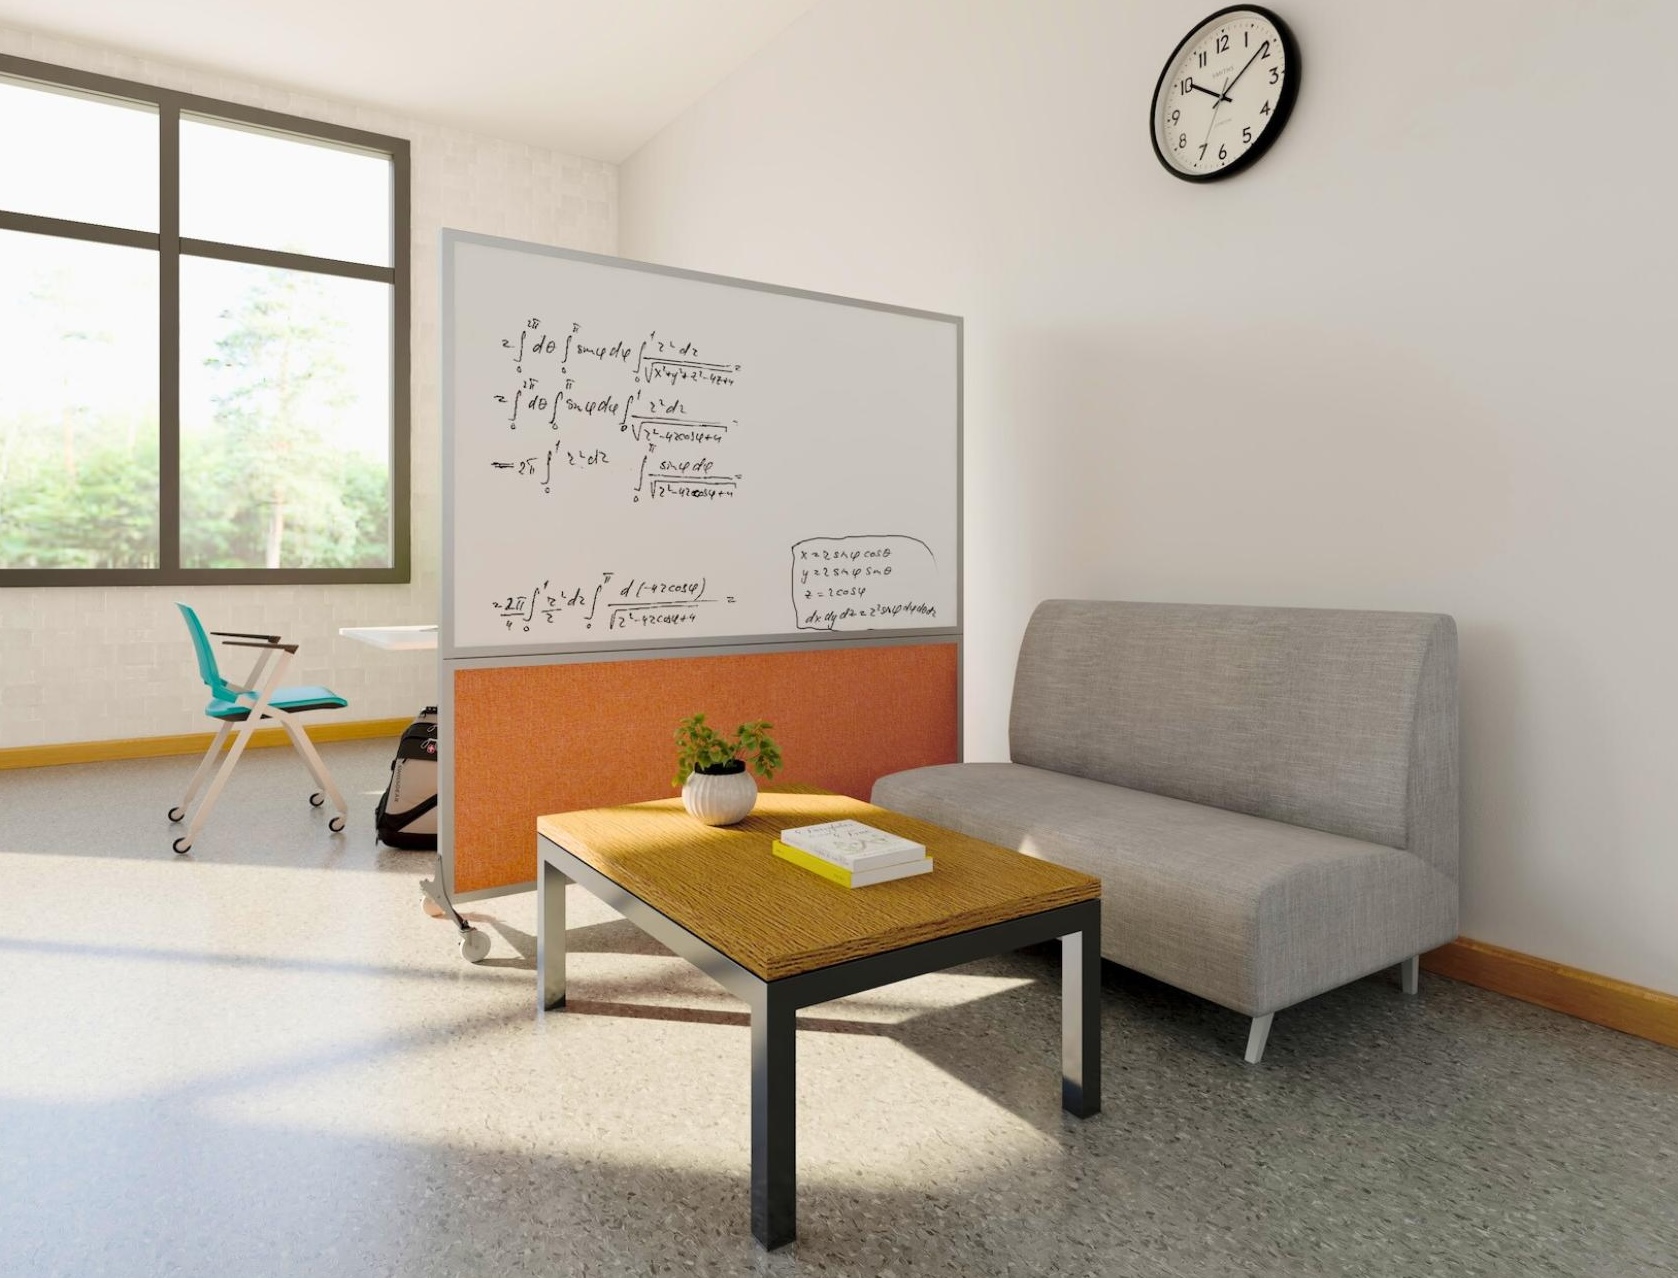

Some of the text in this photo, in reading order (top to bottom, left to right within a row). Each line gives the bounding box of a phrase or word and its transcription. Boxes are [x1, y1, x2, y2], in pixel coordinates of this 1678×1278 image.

[1216, 34, 1230, 54] 12
[1244, 31, 1248, 47] 1
[1199, 51, 1207, 68] 11
[1269, 67, 1279, 85] 3
[1180, 77, 1193, 95] 10
[1260, 100, 1271, 116] 4
[1172, 109, 1180, 126] 9
[1179, 133, 1187, 149] 8
[1242, 127, 1252, 144] 5
[1199, 143, 1208, 161] 7
[1218, 144, 1227, 160] 6
